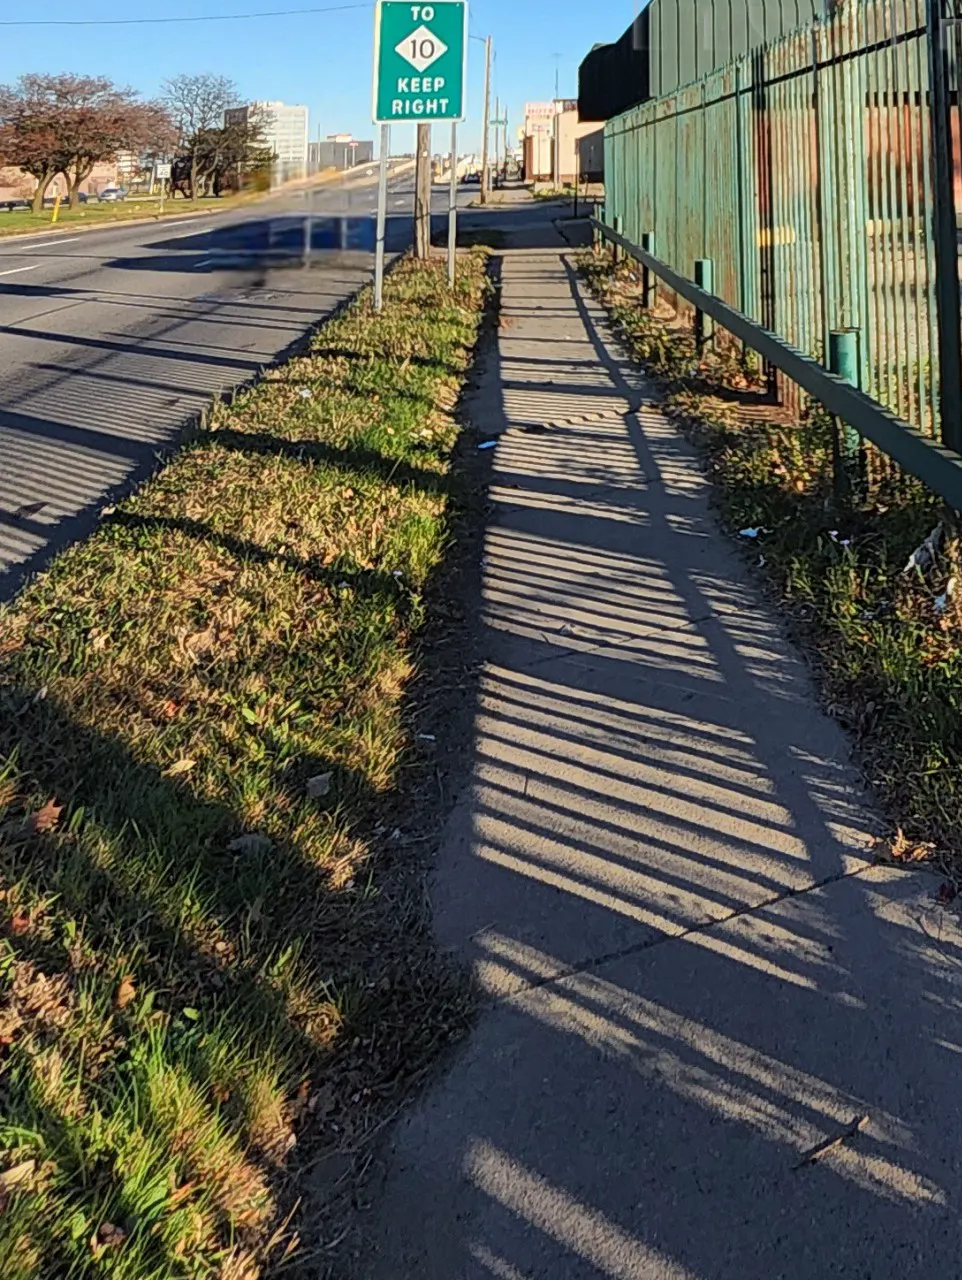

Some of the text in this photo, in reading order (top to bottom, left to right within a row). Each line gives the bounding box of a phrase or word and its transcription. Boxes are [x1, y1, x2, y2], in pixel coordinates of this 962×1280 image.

[410, 6, 435, 21] TO
[411, 39, 435, 59] 10
[397, 77, 445, 93] KEEP
[391, 98, 449, 115] RIGHT
